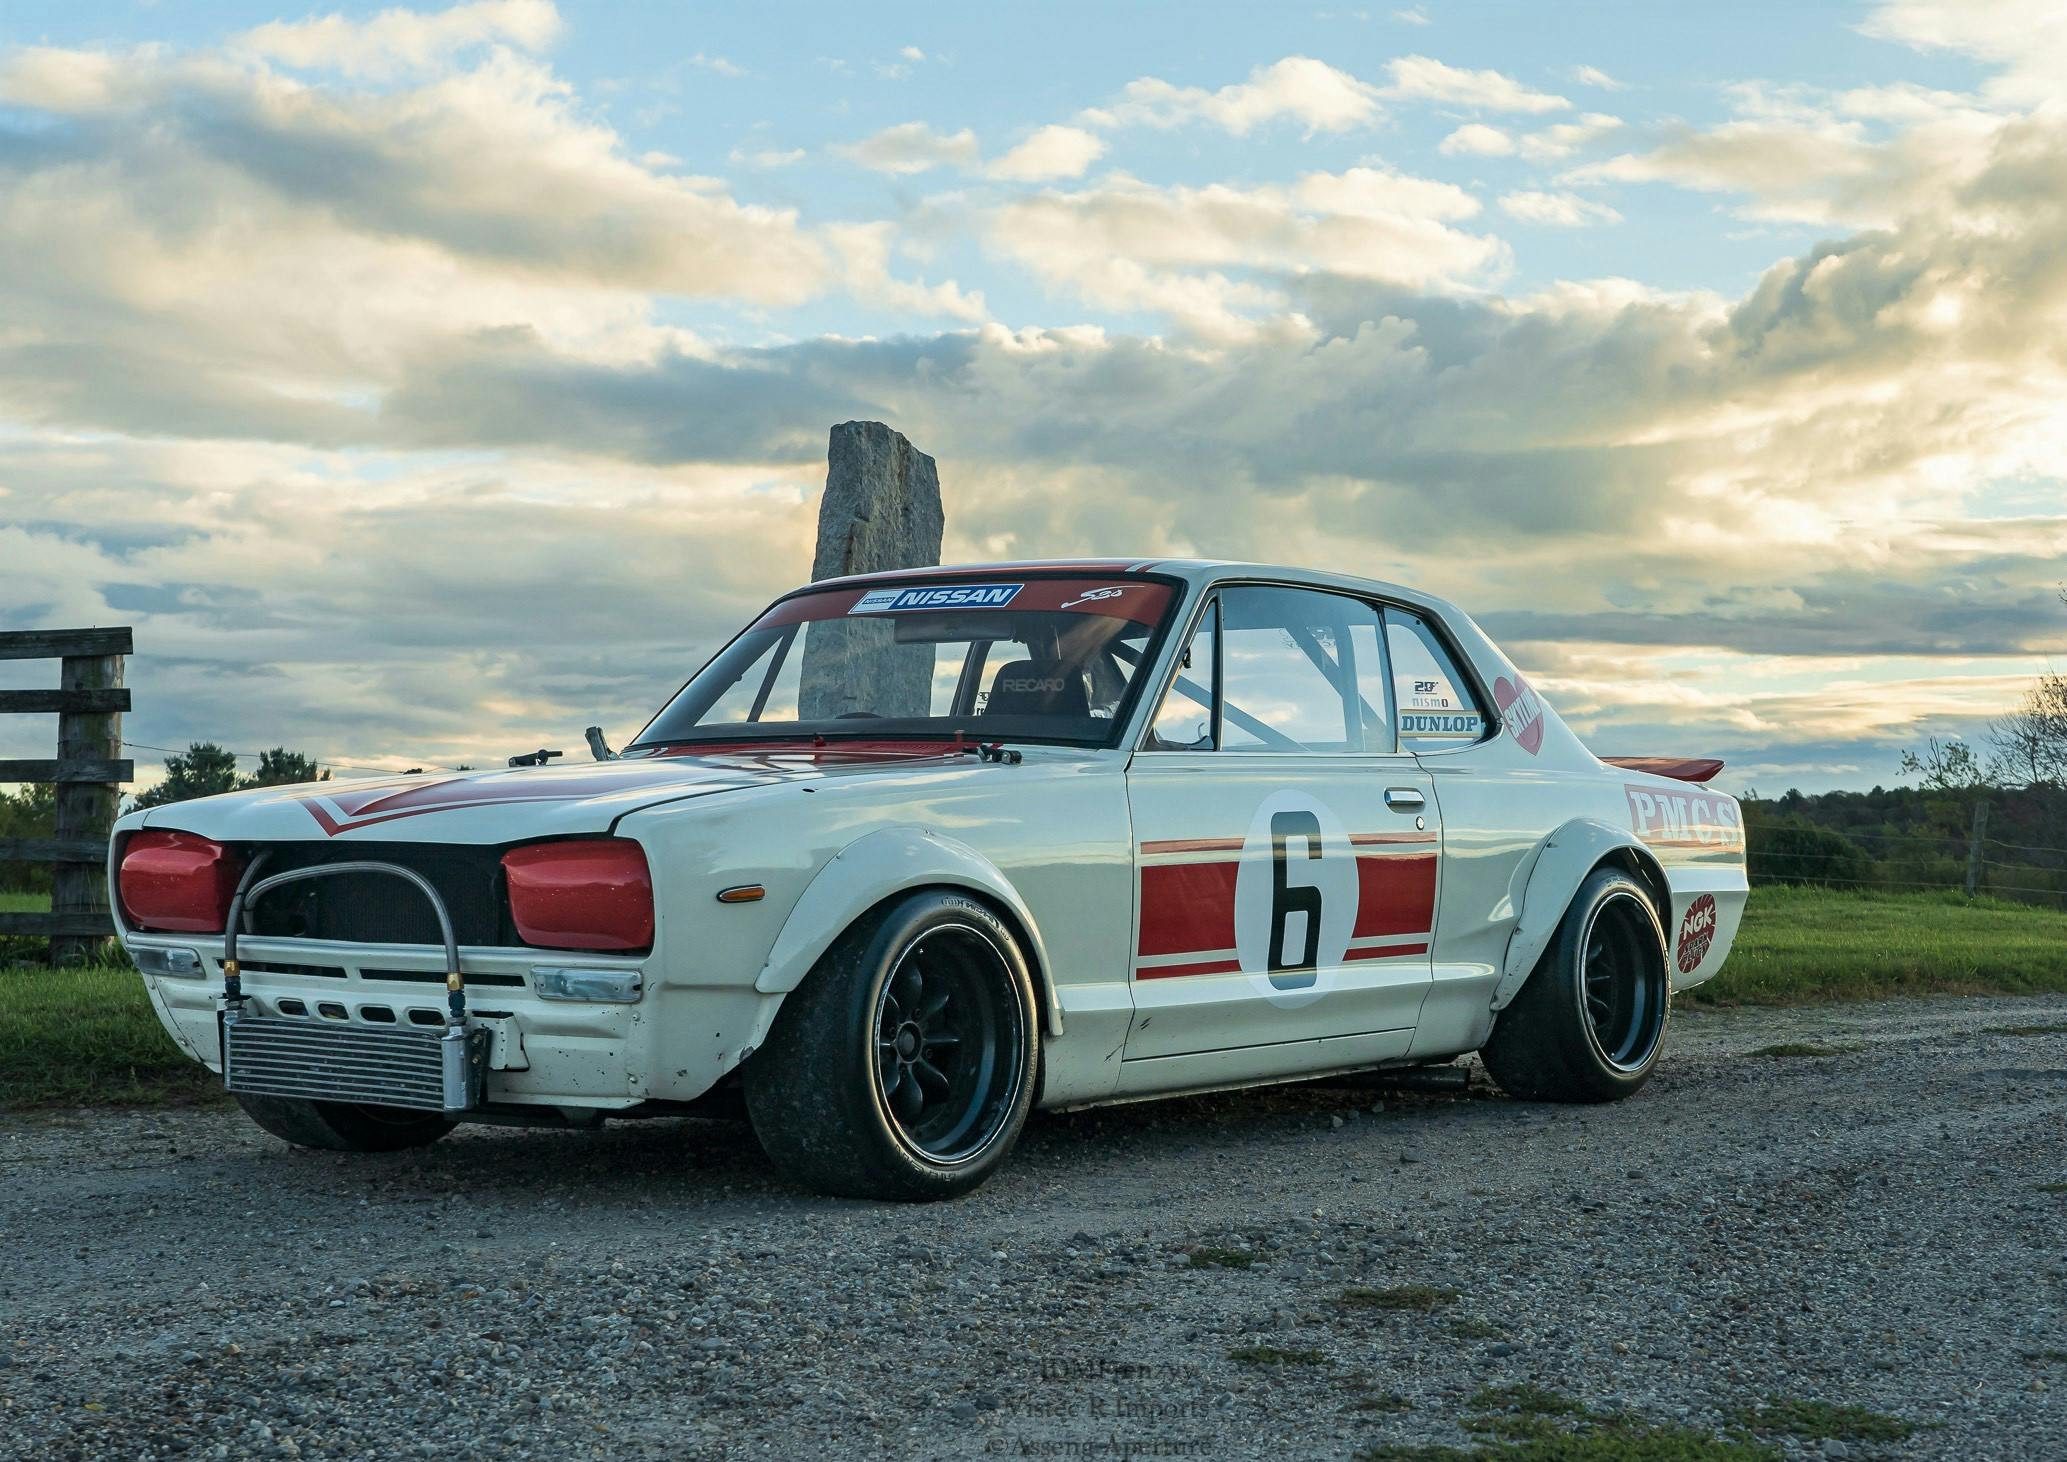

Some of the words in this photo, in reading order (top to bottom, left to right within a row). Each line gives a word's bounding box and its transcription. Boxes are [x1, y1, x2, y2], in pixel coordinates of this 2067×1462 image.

[897, 588, 1012, 606] NISSAN
[1401, 715, 1478, 732] DUNLOP
[1267, 810, 1323, 991] 6
[1683, 903, 1714, 941] NGK
